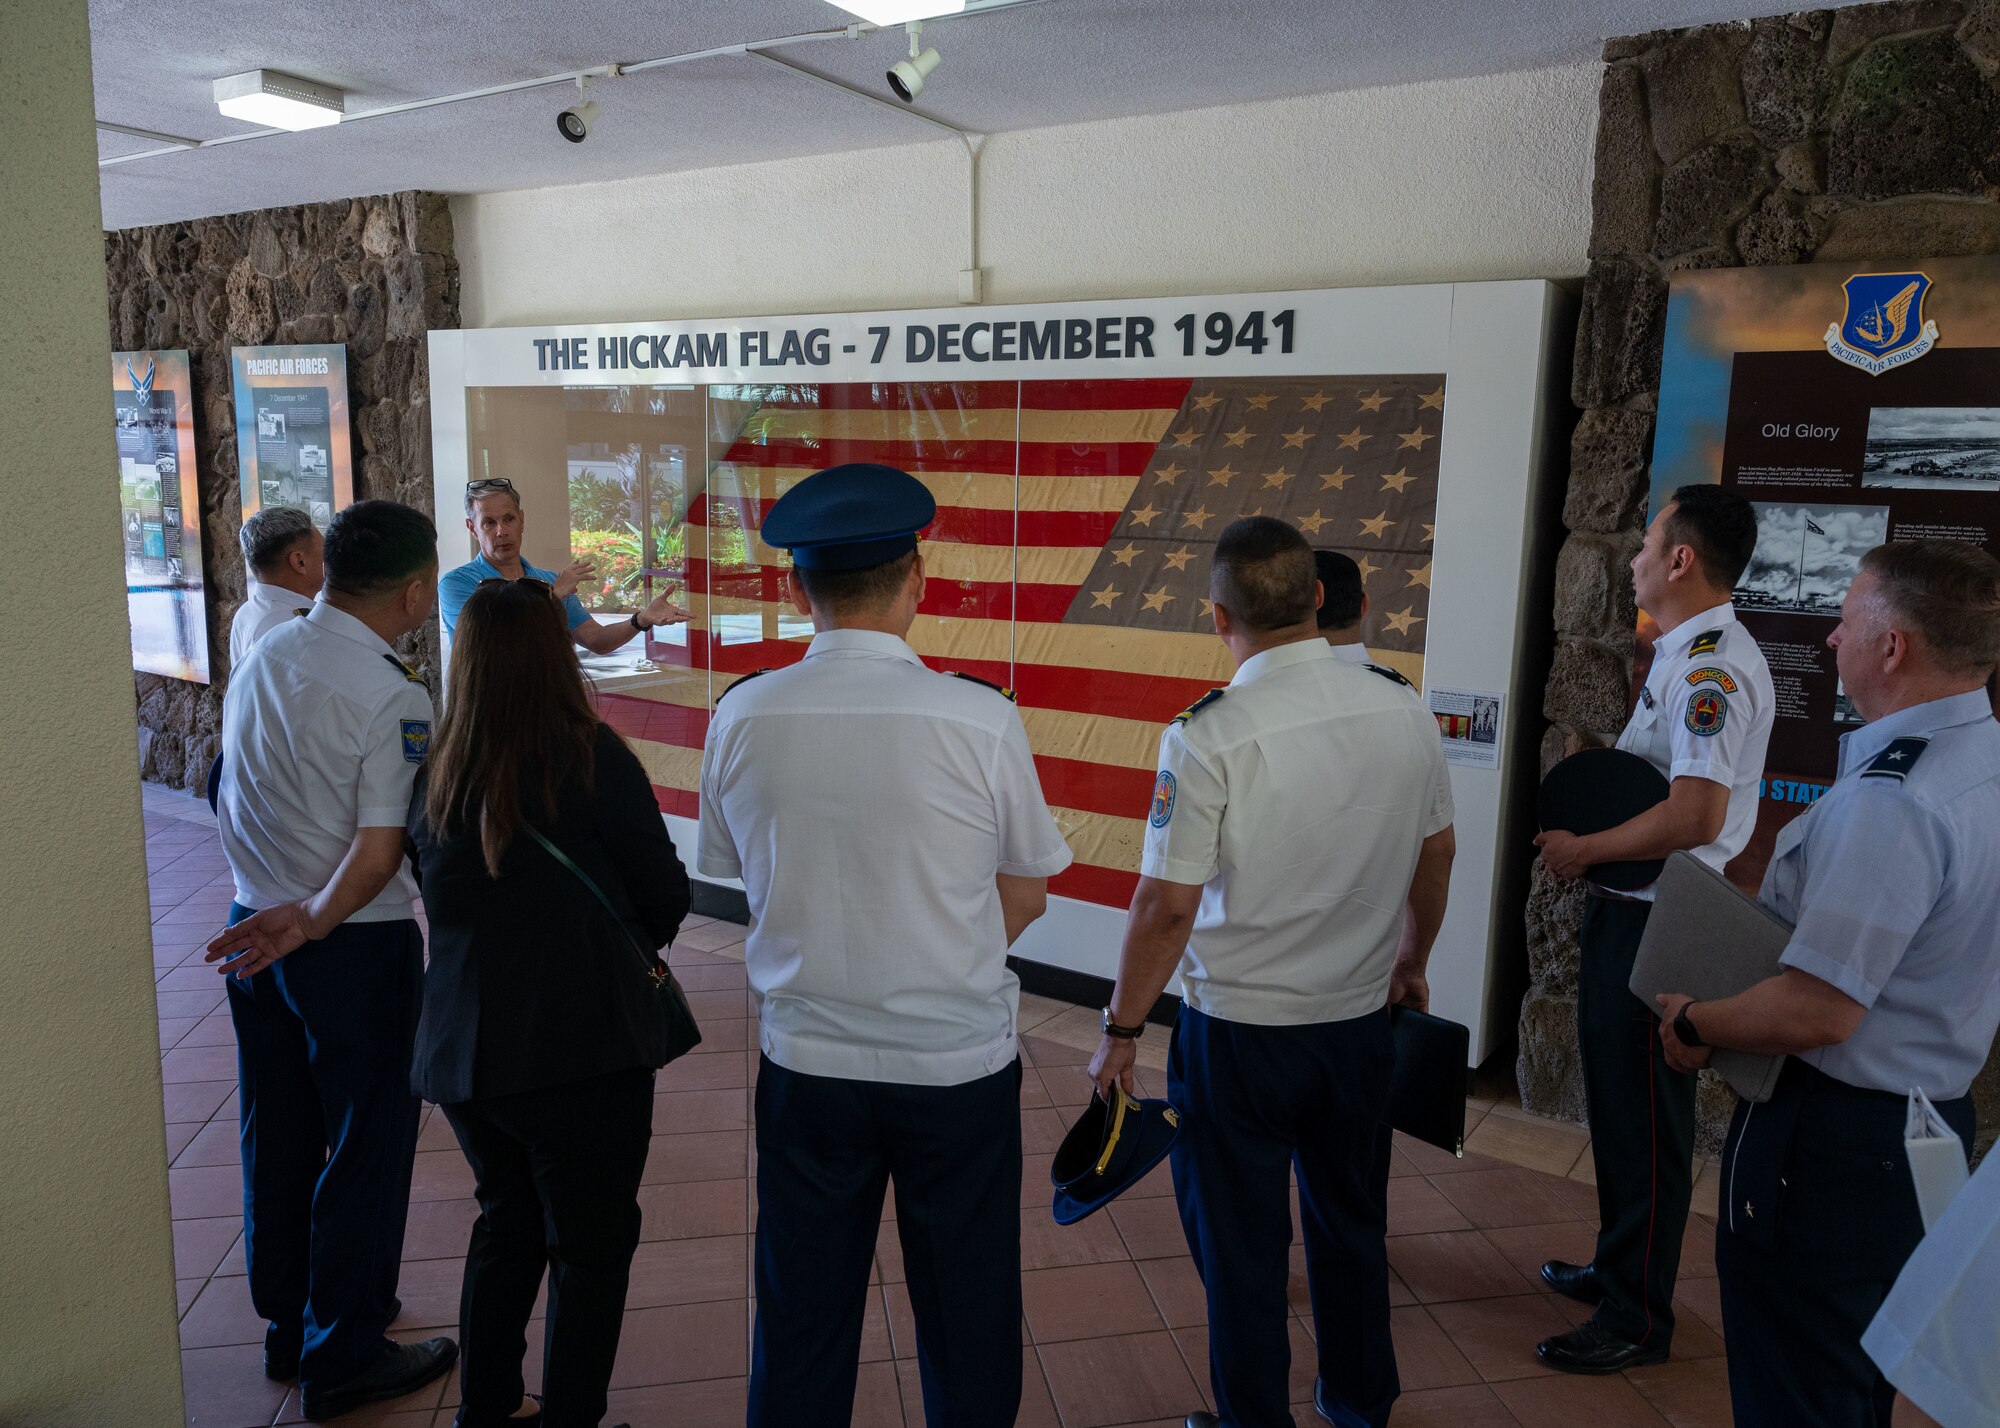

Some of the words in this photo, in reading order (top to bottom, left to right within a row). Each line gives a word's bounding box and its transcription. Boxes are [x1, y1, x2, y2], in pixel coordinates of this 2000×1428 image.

[533, 337, 588, 370] THE
[598, 332, 728, 370] HICKAM
[740, 328, 830, 367] FLAG
[842, 345, 855, 353] -
[867, 326, 890, 364] 7
[905, 316, 1155, 363] DECEMBER
[1173, 309, 1295, 356] 1941
[1830, 342, 1866, 365] PACIFIC
[1866, 361, 1886, 372] AIR
[1887, 340, 1929, 366] FORCES
[246, 359, 278, 376] PACIFIC
[280, 358, 294, 375] AIR
[295, 357, 329, 375] FORCES
[1762, 424, 1790, 438] Old
[1795, 424, 1840, 441] Glory
[1690, 671, 1733, 690] MONGOLIA
